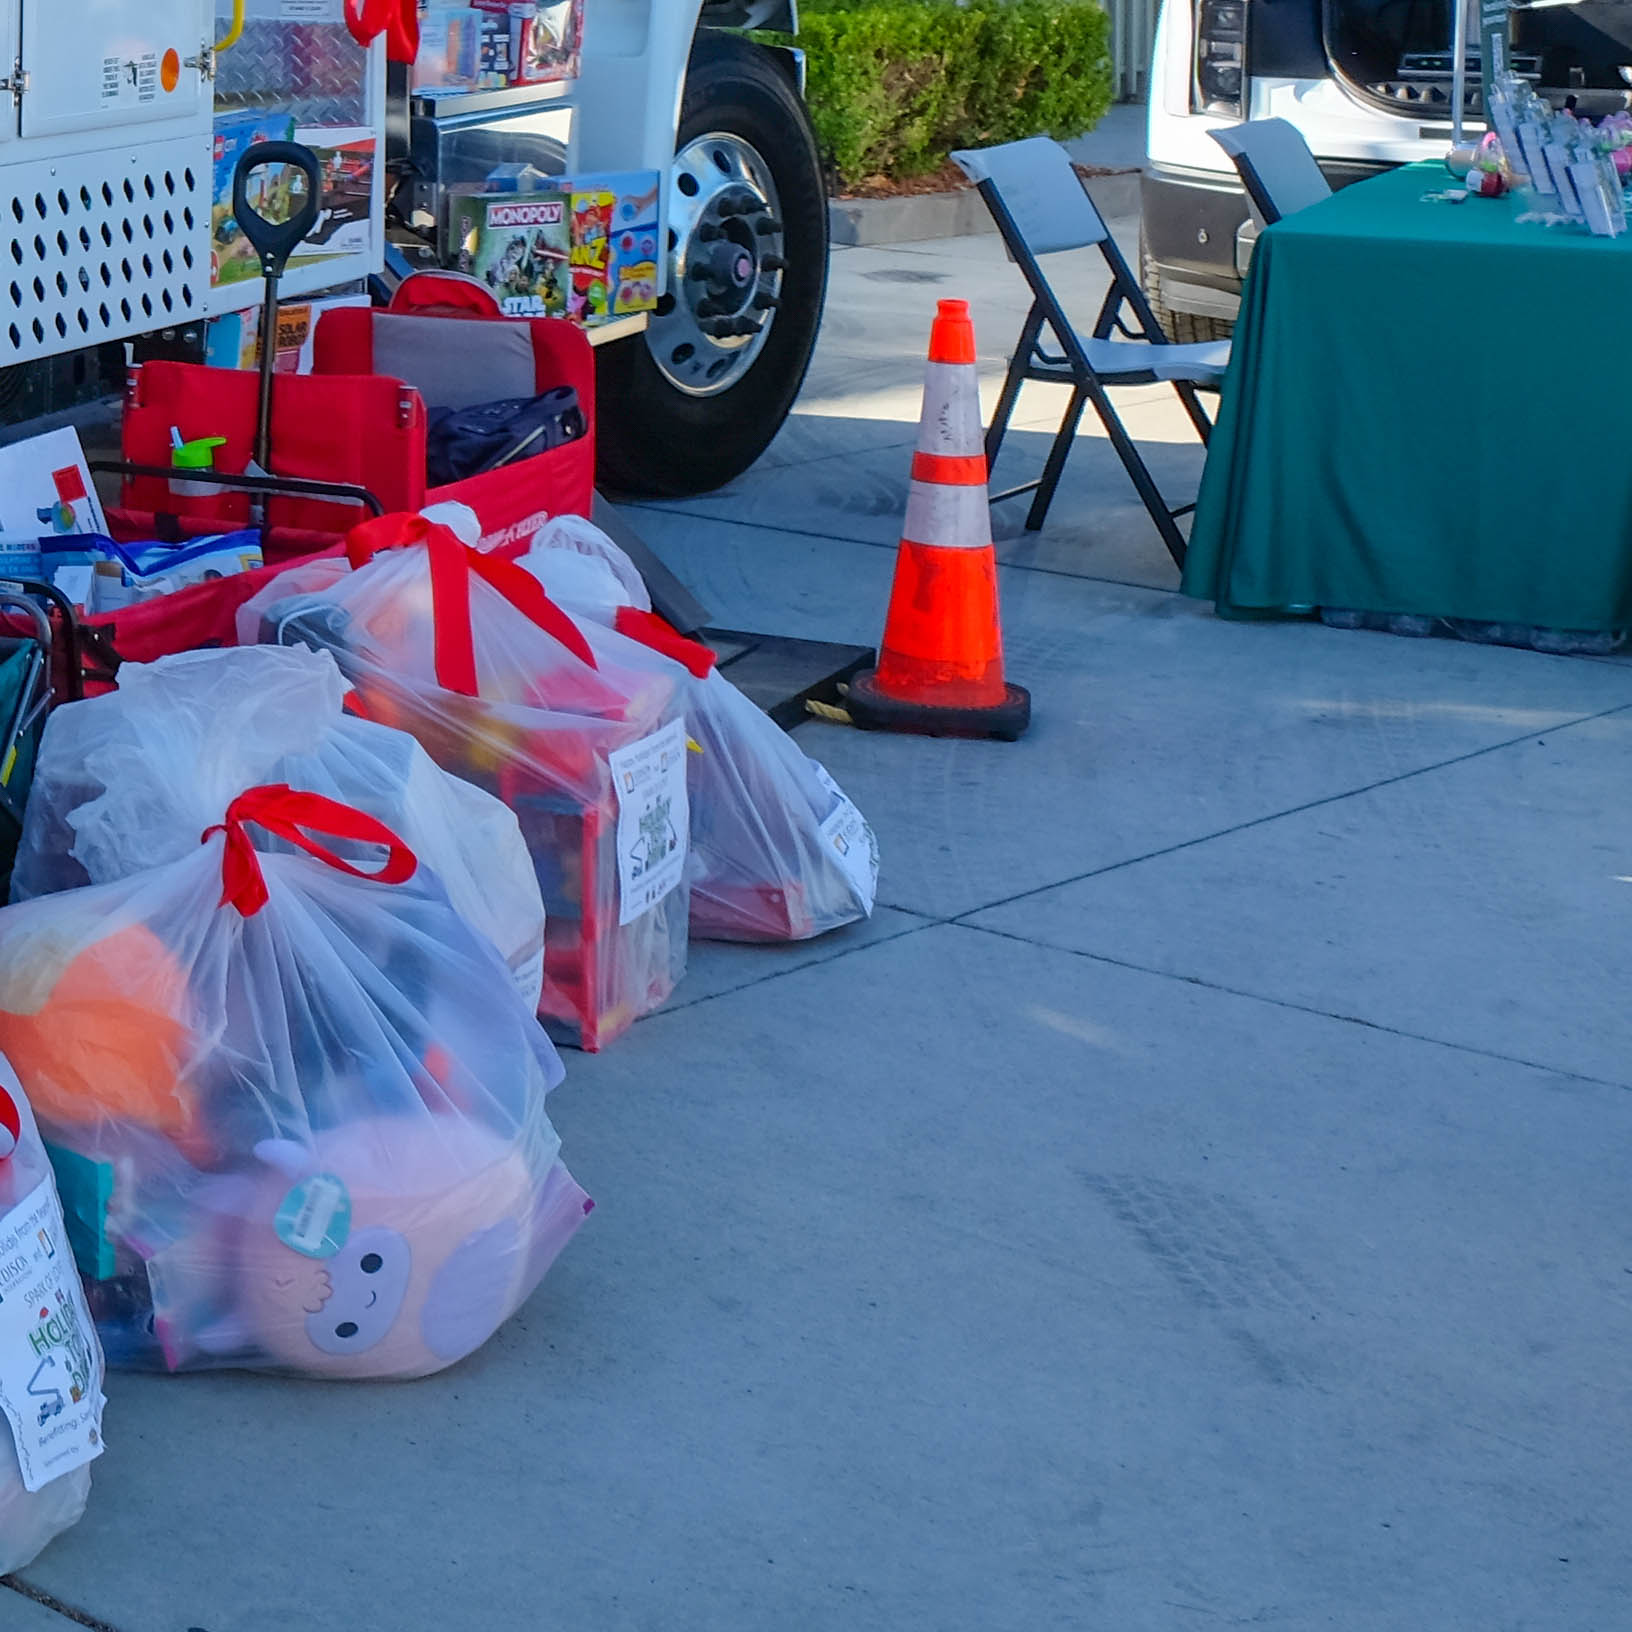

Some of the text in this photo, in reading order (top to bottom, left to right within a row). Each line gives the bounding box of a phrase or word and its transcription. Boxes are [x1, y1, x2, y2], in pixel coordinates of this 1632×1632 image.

[489, 208, 561, 227] MONOPOLY
[502, 297, 545, 314] STAR
[279, 321, 307, 335] SOLAR
[23, 1282, 46, 1309] SPARK
